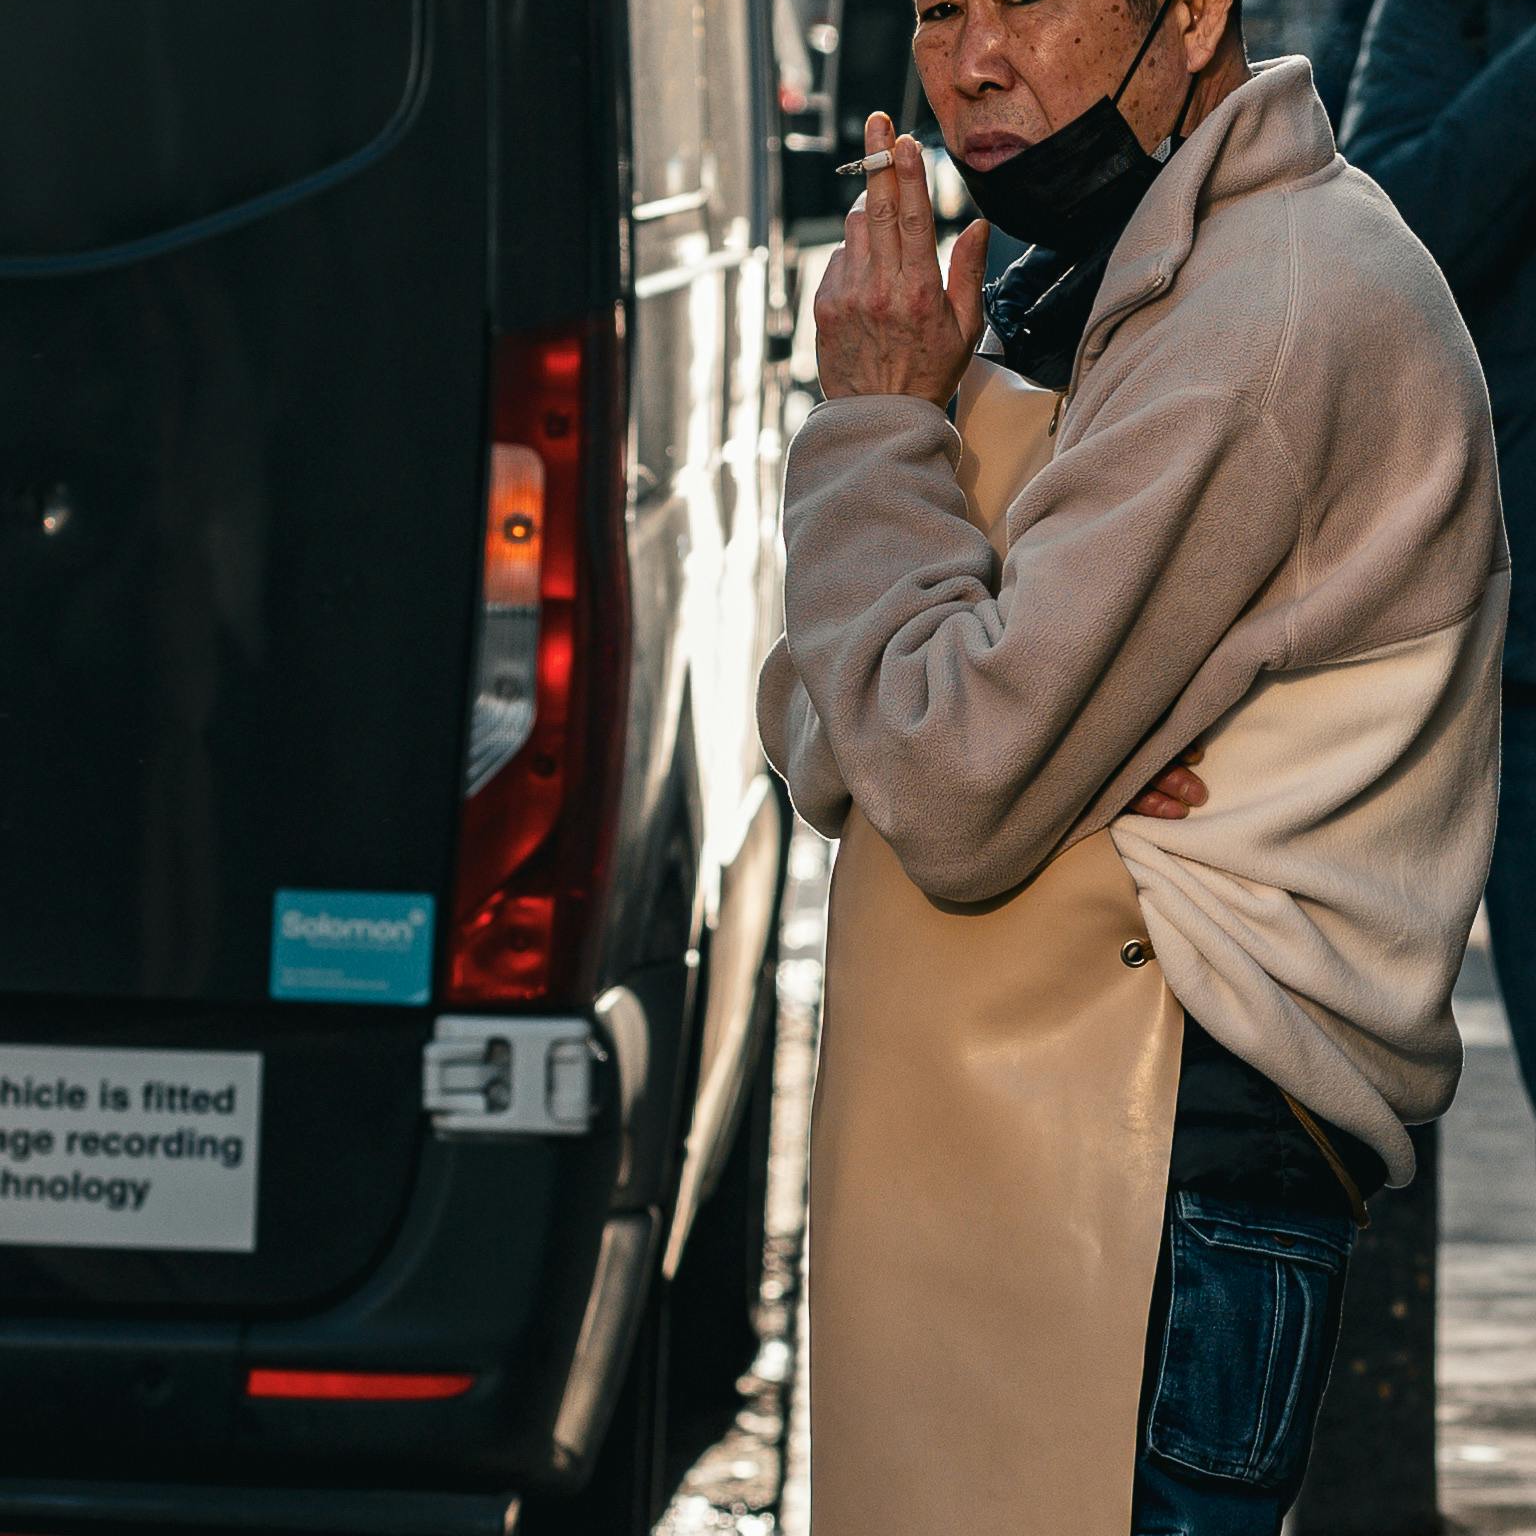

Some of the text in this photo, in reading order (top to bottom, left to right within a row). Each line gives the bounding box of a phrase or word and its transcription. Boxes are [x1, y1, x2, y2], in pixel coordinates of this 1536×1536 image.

[281, 908, 414, 943] Solomon
[99, 1079, 129, 1112] is
[143, 1081, 236, 1114] fitted
[67, 1128, 243, 1168] recording
